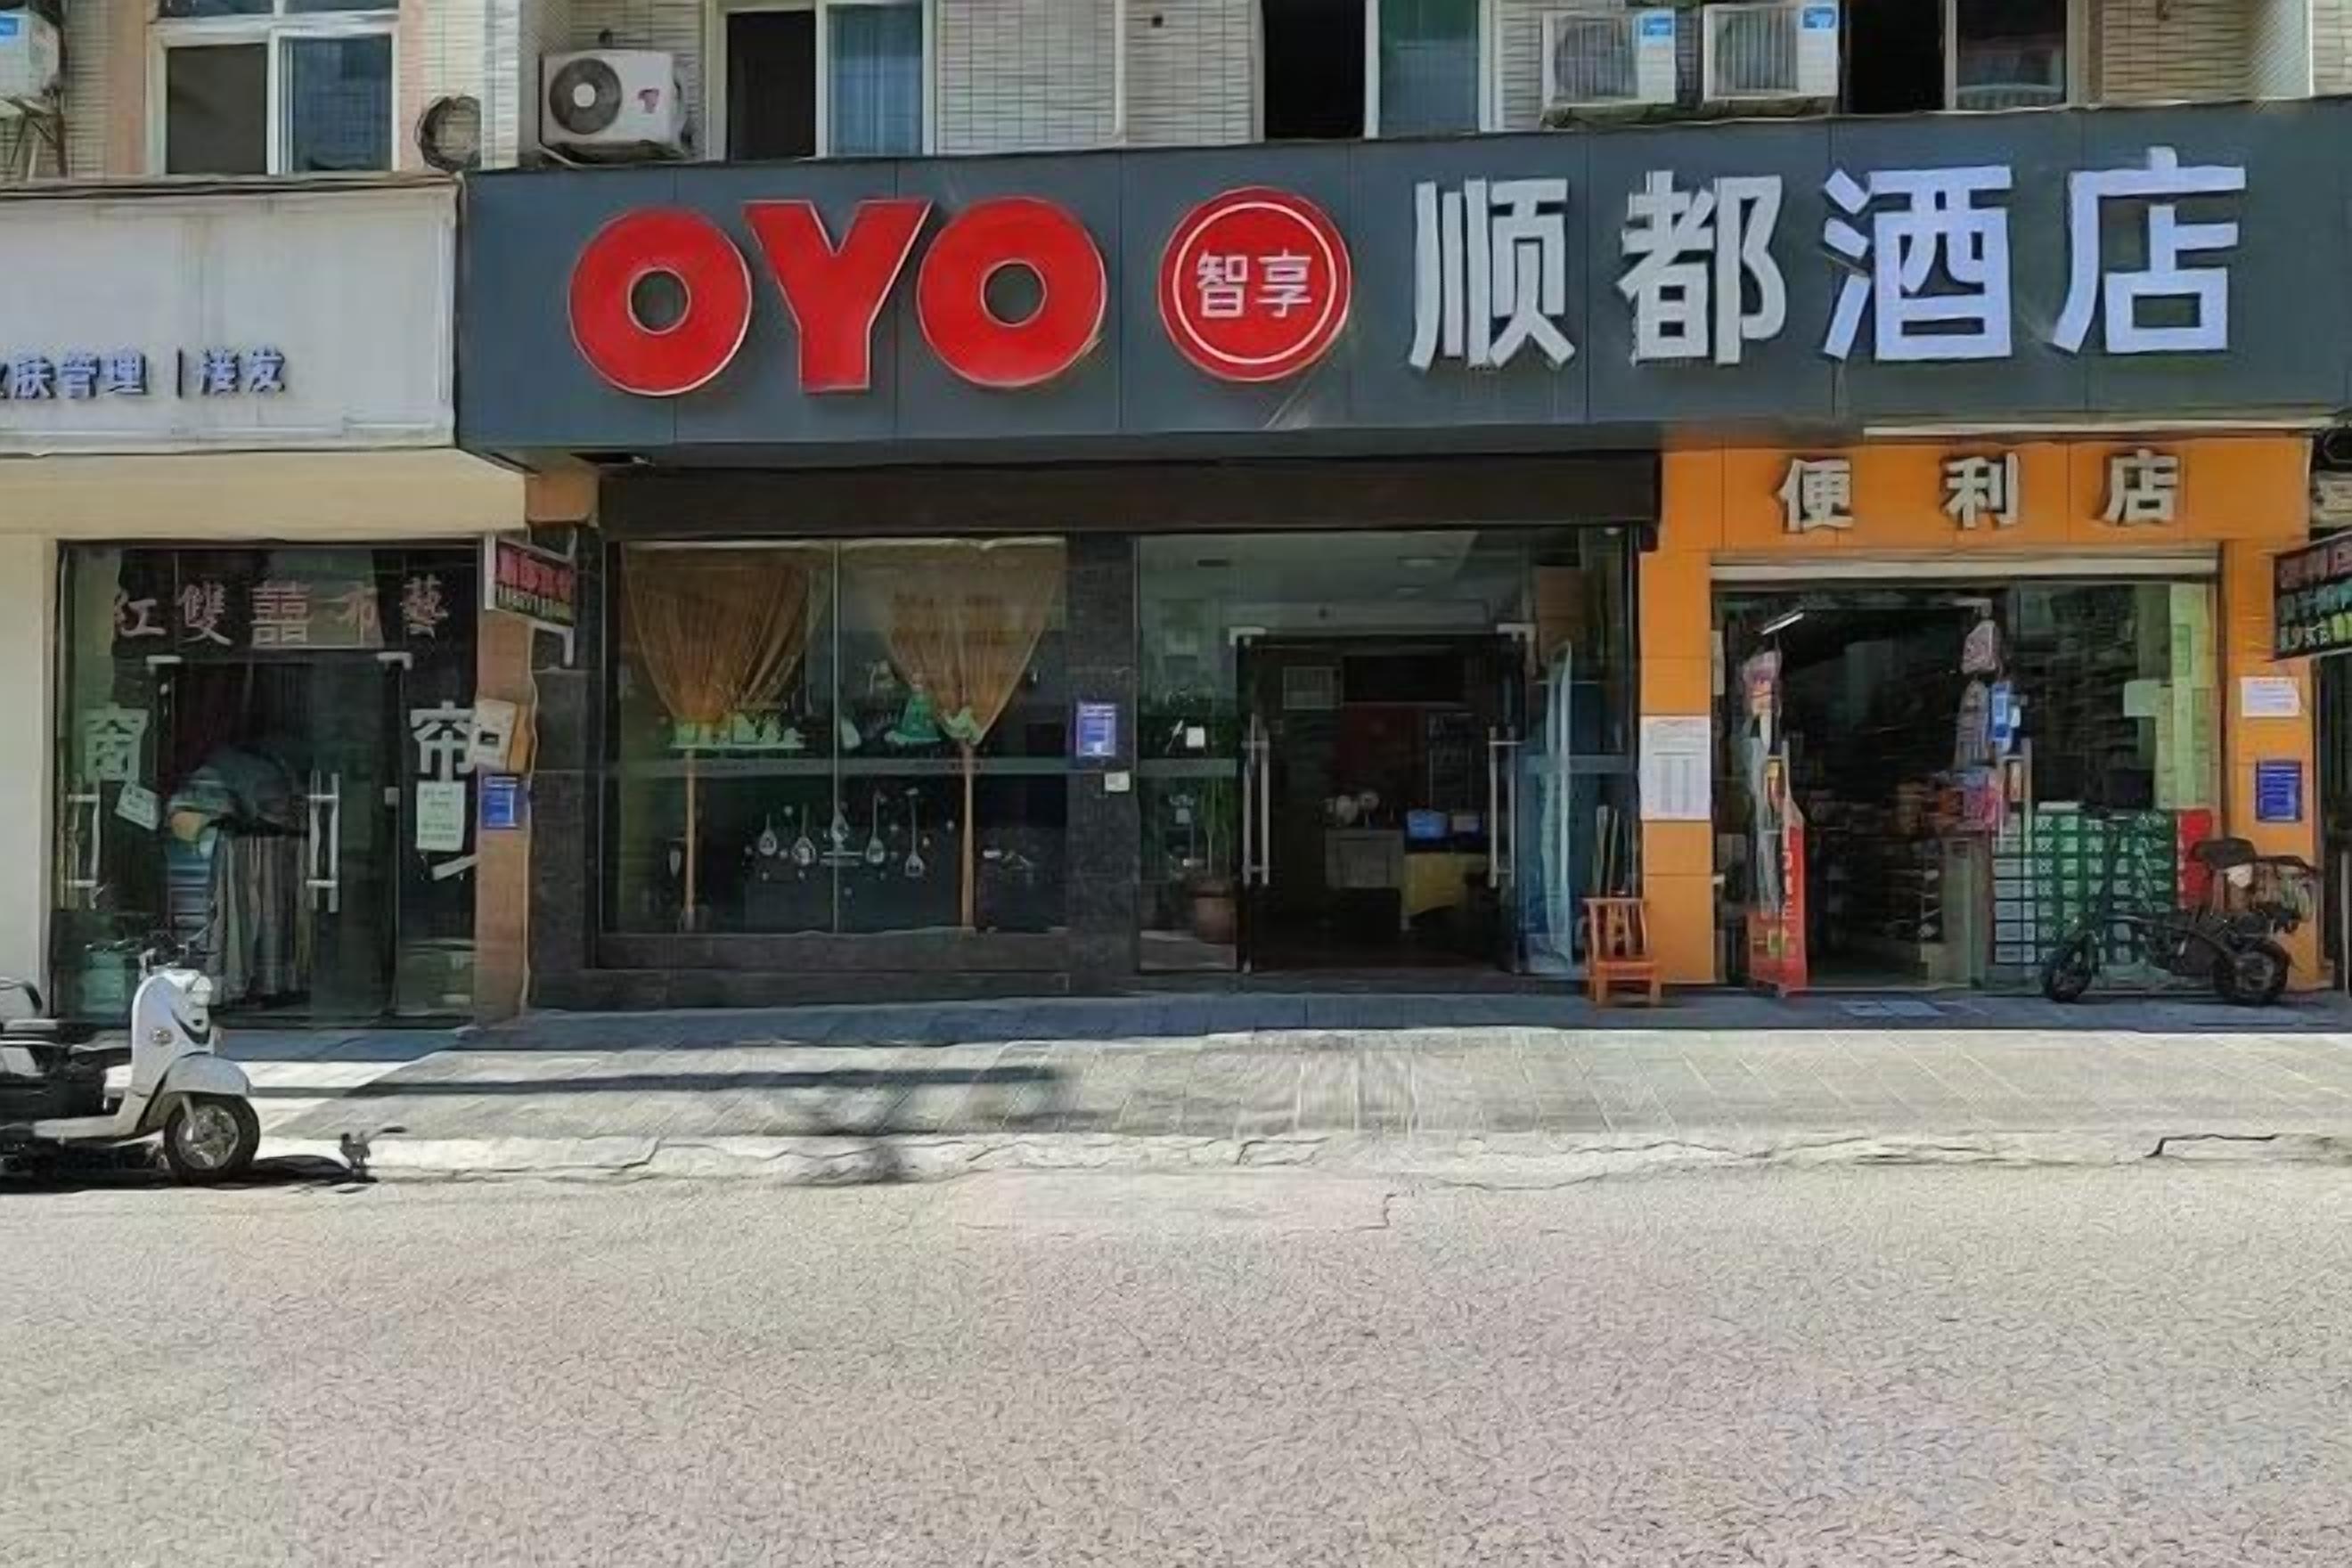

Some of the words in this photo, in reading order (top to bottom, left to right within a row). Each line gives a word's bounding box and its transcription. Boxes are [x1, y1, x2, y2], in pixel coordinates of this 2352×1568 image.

[568, 196, 1108, 397] OYO
[1196, 249, 1312, 319] 智享
[1410, 147, 2246, 370] 顺都酒店
[0, 349, 148, 399] 肤管理
[1780, 448, 2181, 532] 便利店
